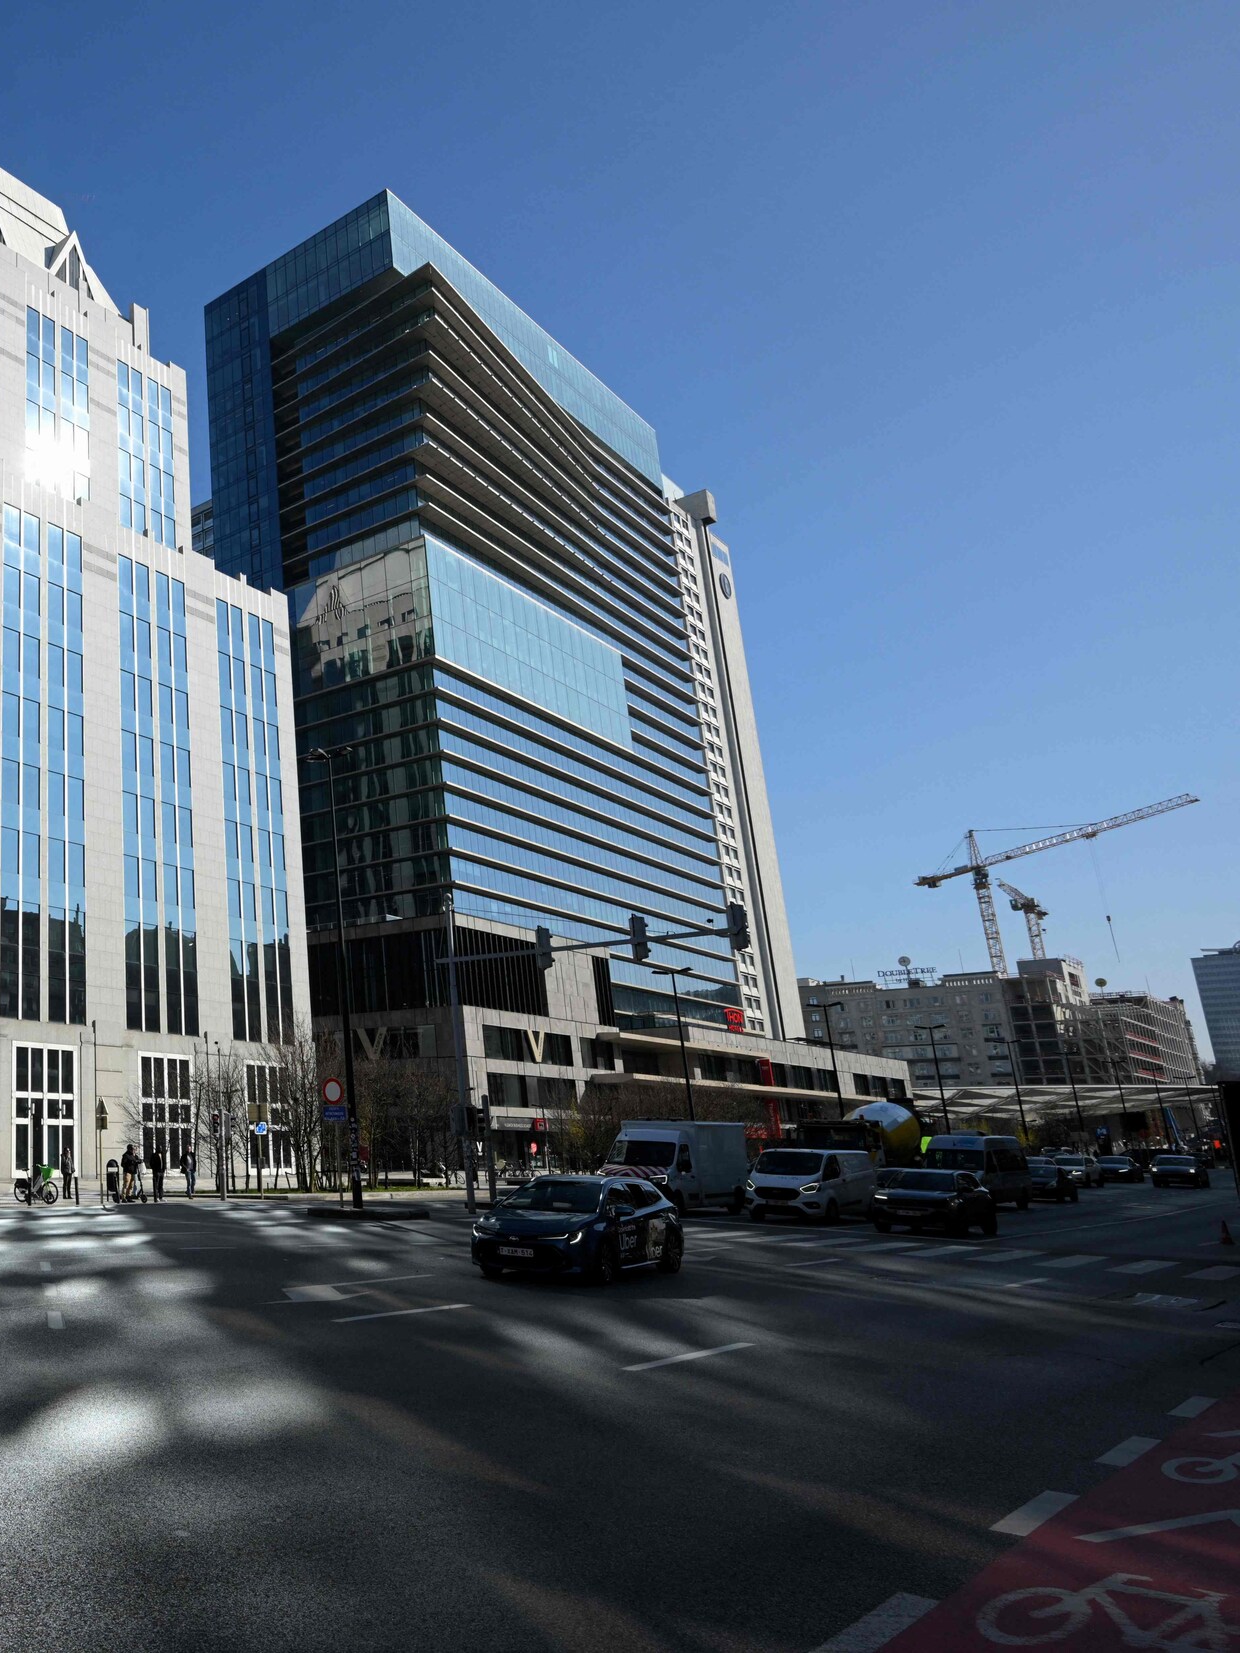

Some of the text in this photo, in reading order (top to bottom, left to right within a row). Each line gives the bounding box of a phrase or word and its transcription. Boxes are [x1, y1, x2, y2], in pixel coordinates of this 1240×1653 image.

[724, 1007, 744, 1024] THON
[526, 1028, 545, 1062] V
[619, 1233, 637, 1250] Uber
